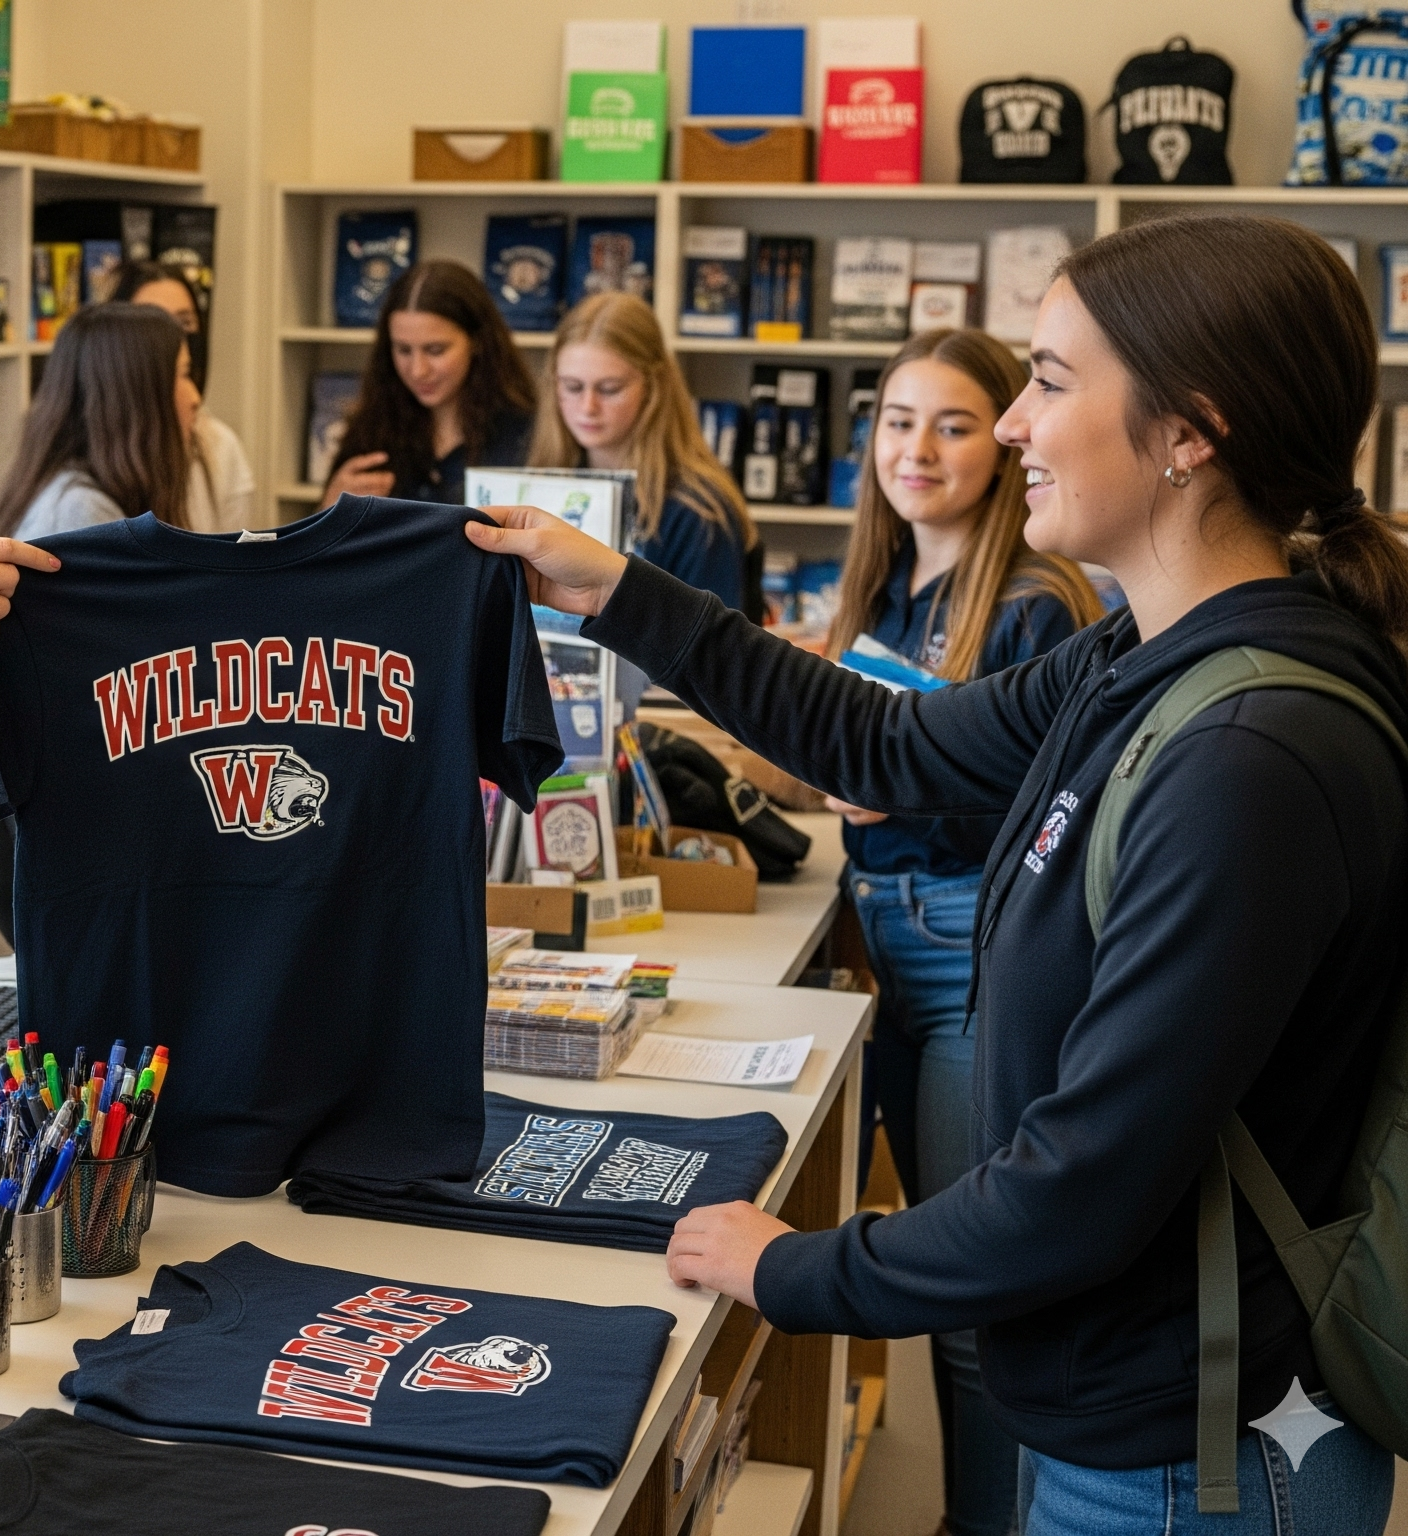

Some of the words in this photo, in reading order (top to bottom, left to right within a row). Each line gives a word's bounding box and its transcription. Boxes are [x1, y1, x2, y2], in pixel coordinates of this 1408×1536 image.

[94, 636, 414, 762] WILDCATS
[198, 750, 284, 830] W
[257, 1285, 473, 1427] WILDCATS
